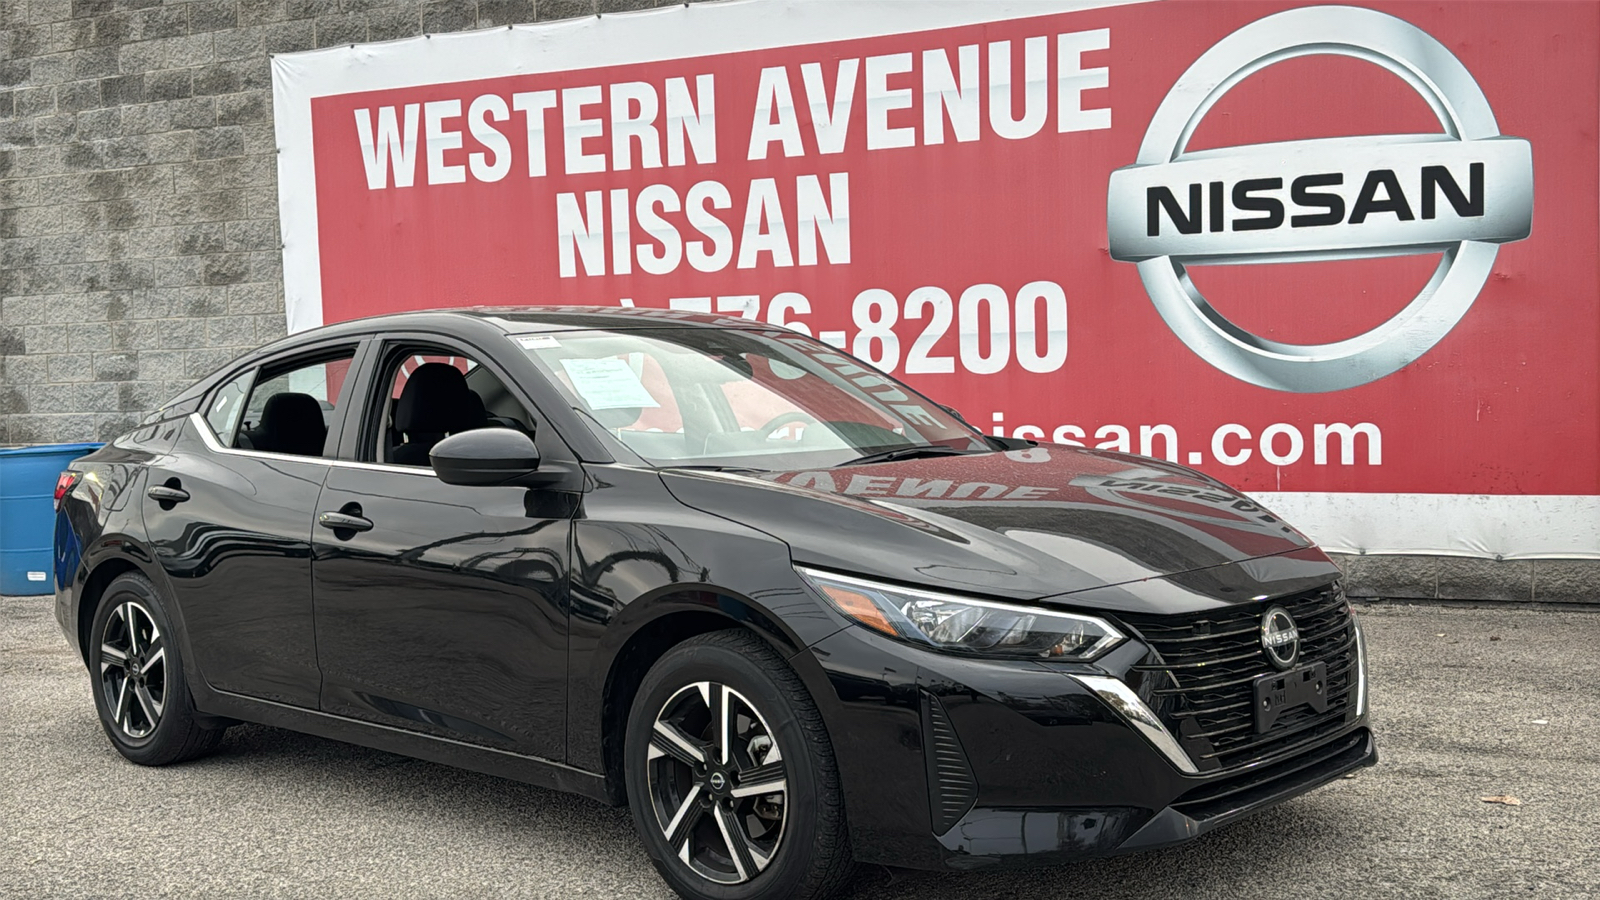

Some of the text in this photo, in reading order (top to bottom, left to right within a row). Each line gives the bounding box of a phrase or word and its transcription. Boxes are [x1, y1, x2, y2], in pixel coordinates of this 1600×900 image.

[353, 27, 1112, 191] WESTERN AVENUE
[556, 171, 851, 279] NISSAN
[1146, 162, 1485, 237] NISSAN
[1264, 629, 1299, 646] NISSAN
